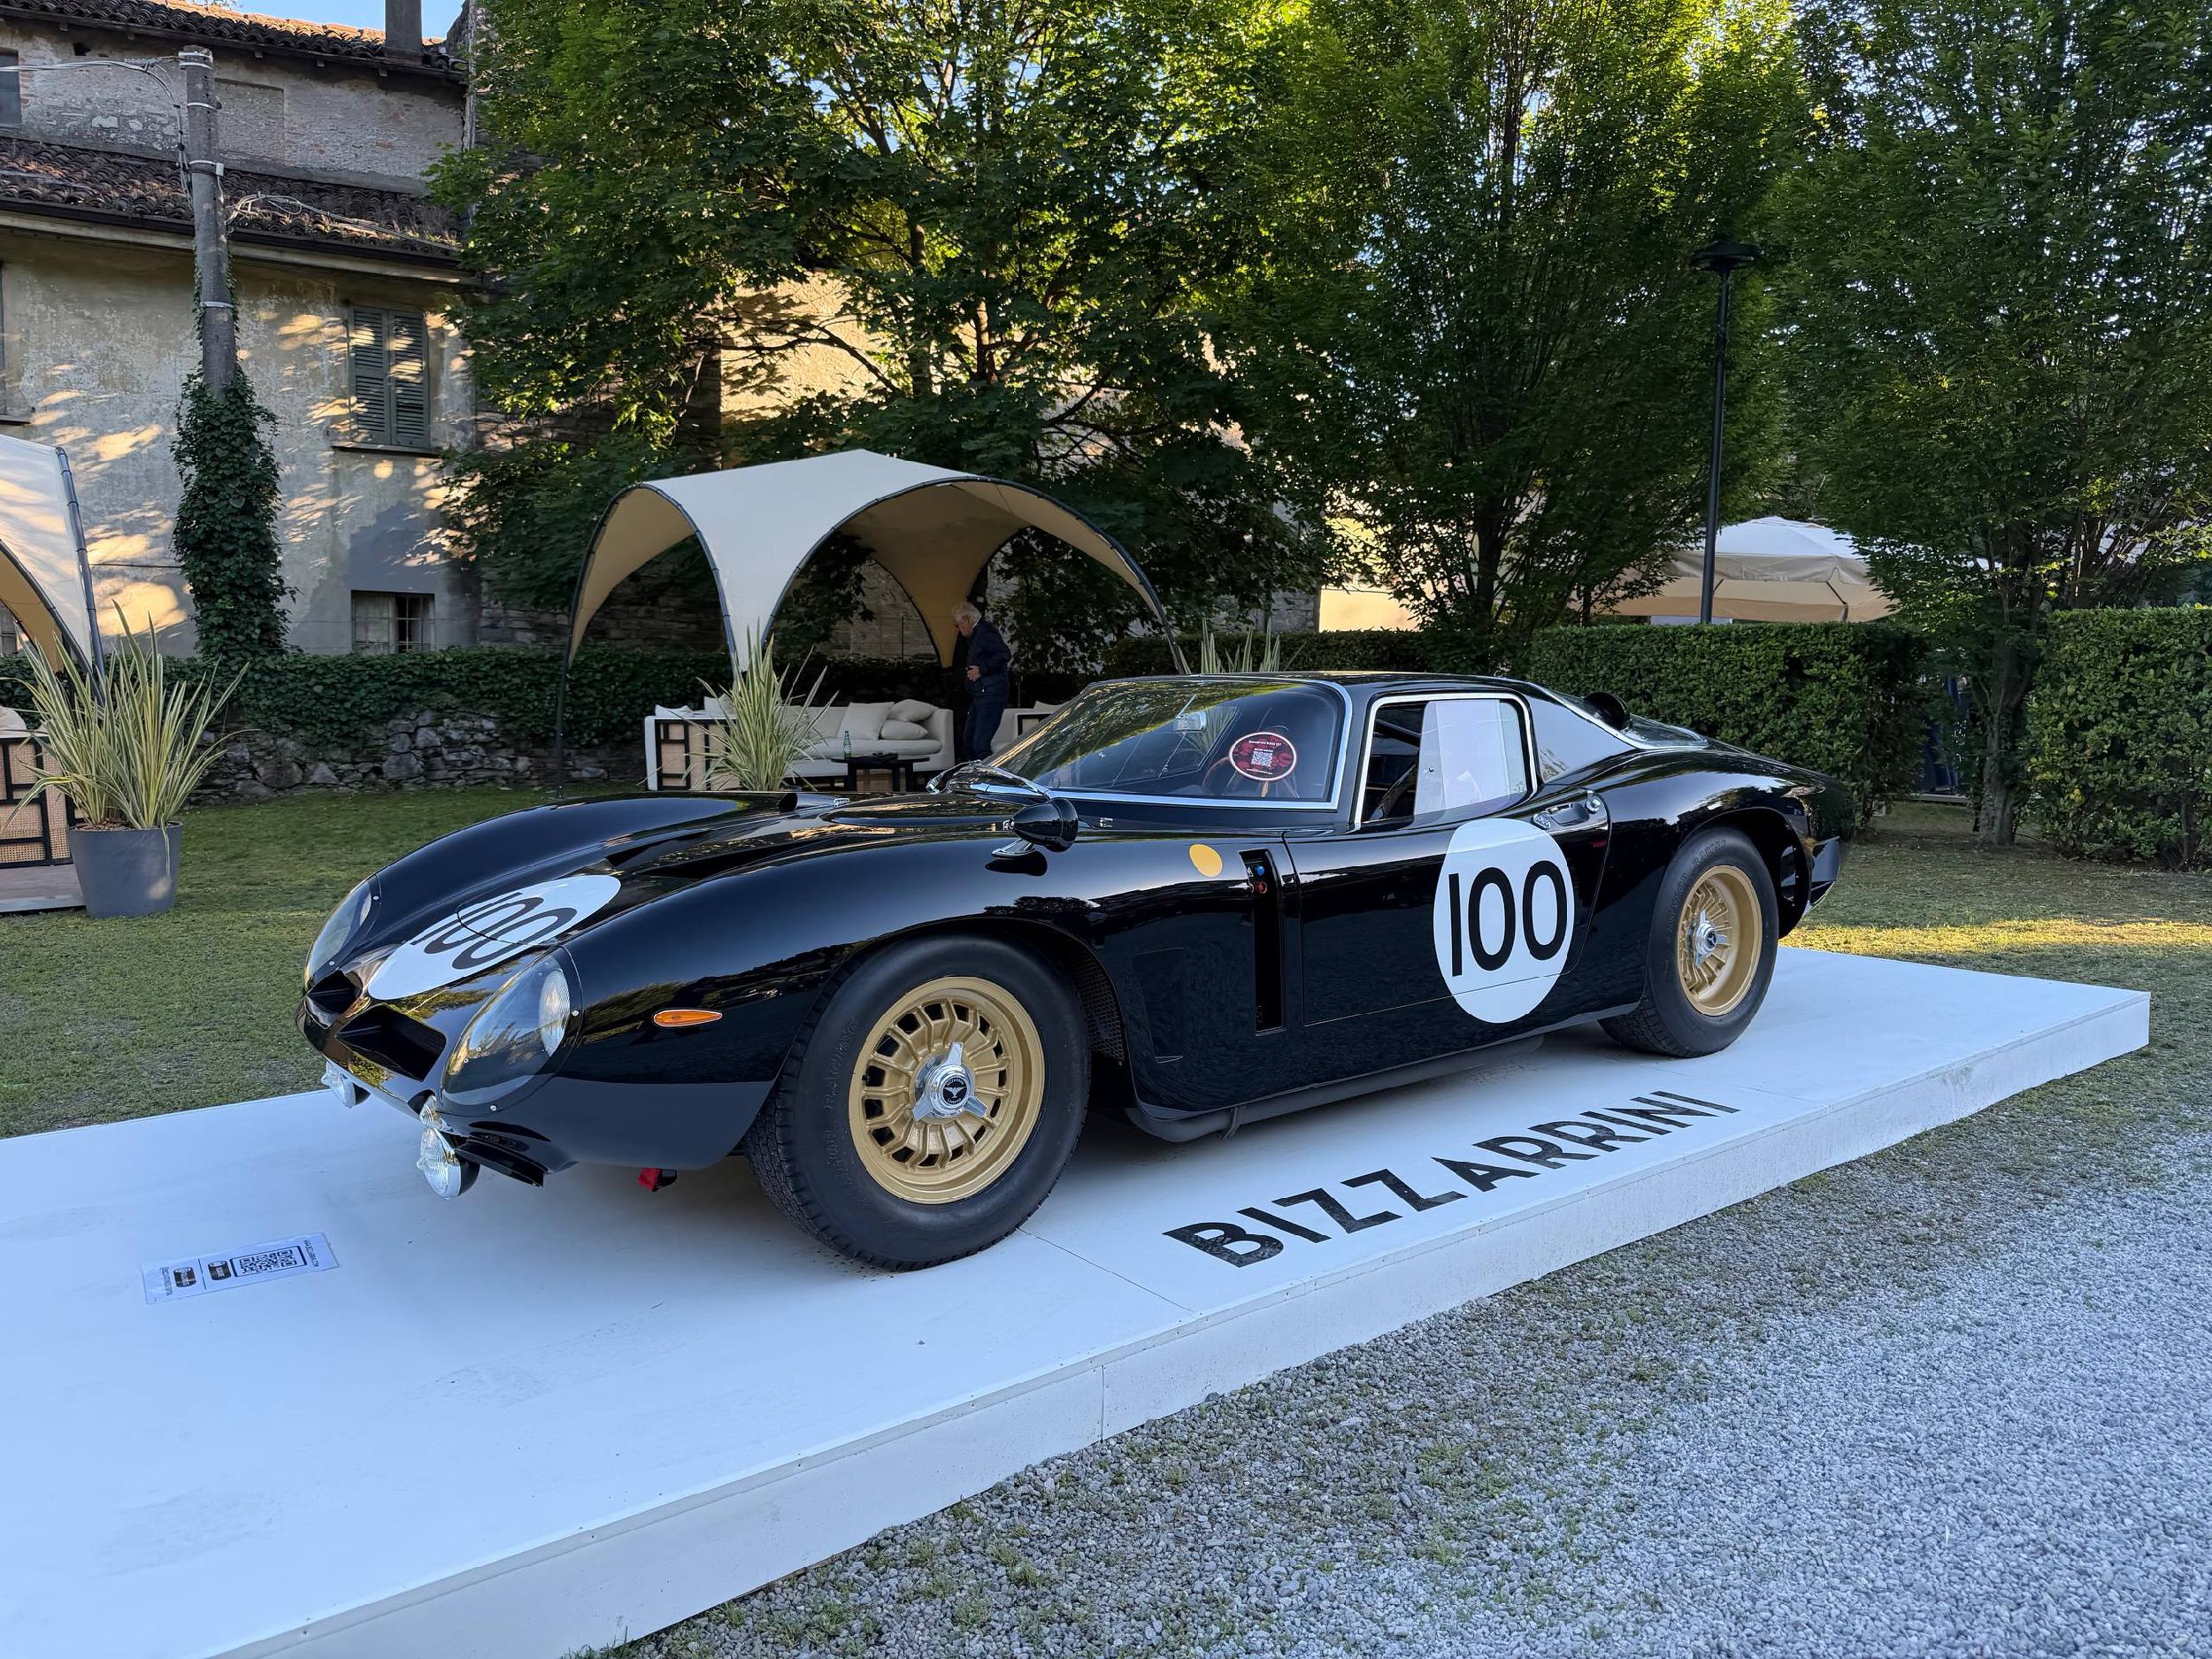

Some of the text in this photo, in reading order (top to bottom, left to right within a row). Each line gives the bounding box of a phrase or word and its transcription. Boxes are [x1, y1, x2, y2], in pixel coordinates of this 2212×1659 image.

[410, 892, 578, 970] 100
[1448, 860, 1568, 978] 100
[1162, 1090, 1740, 1268] BIZZARRINI
